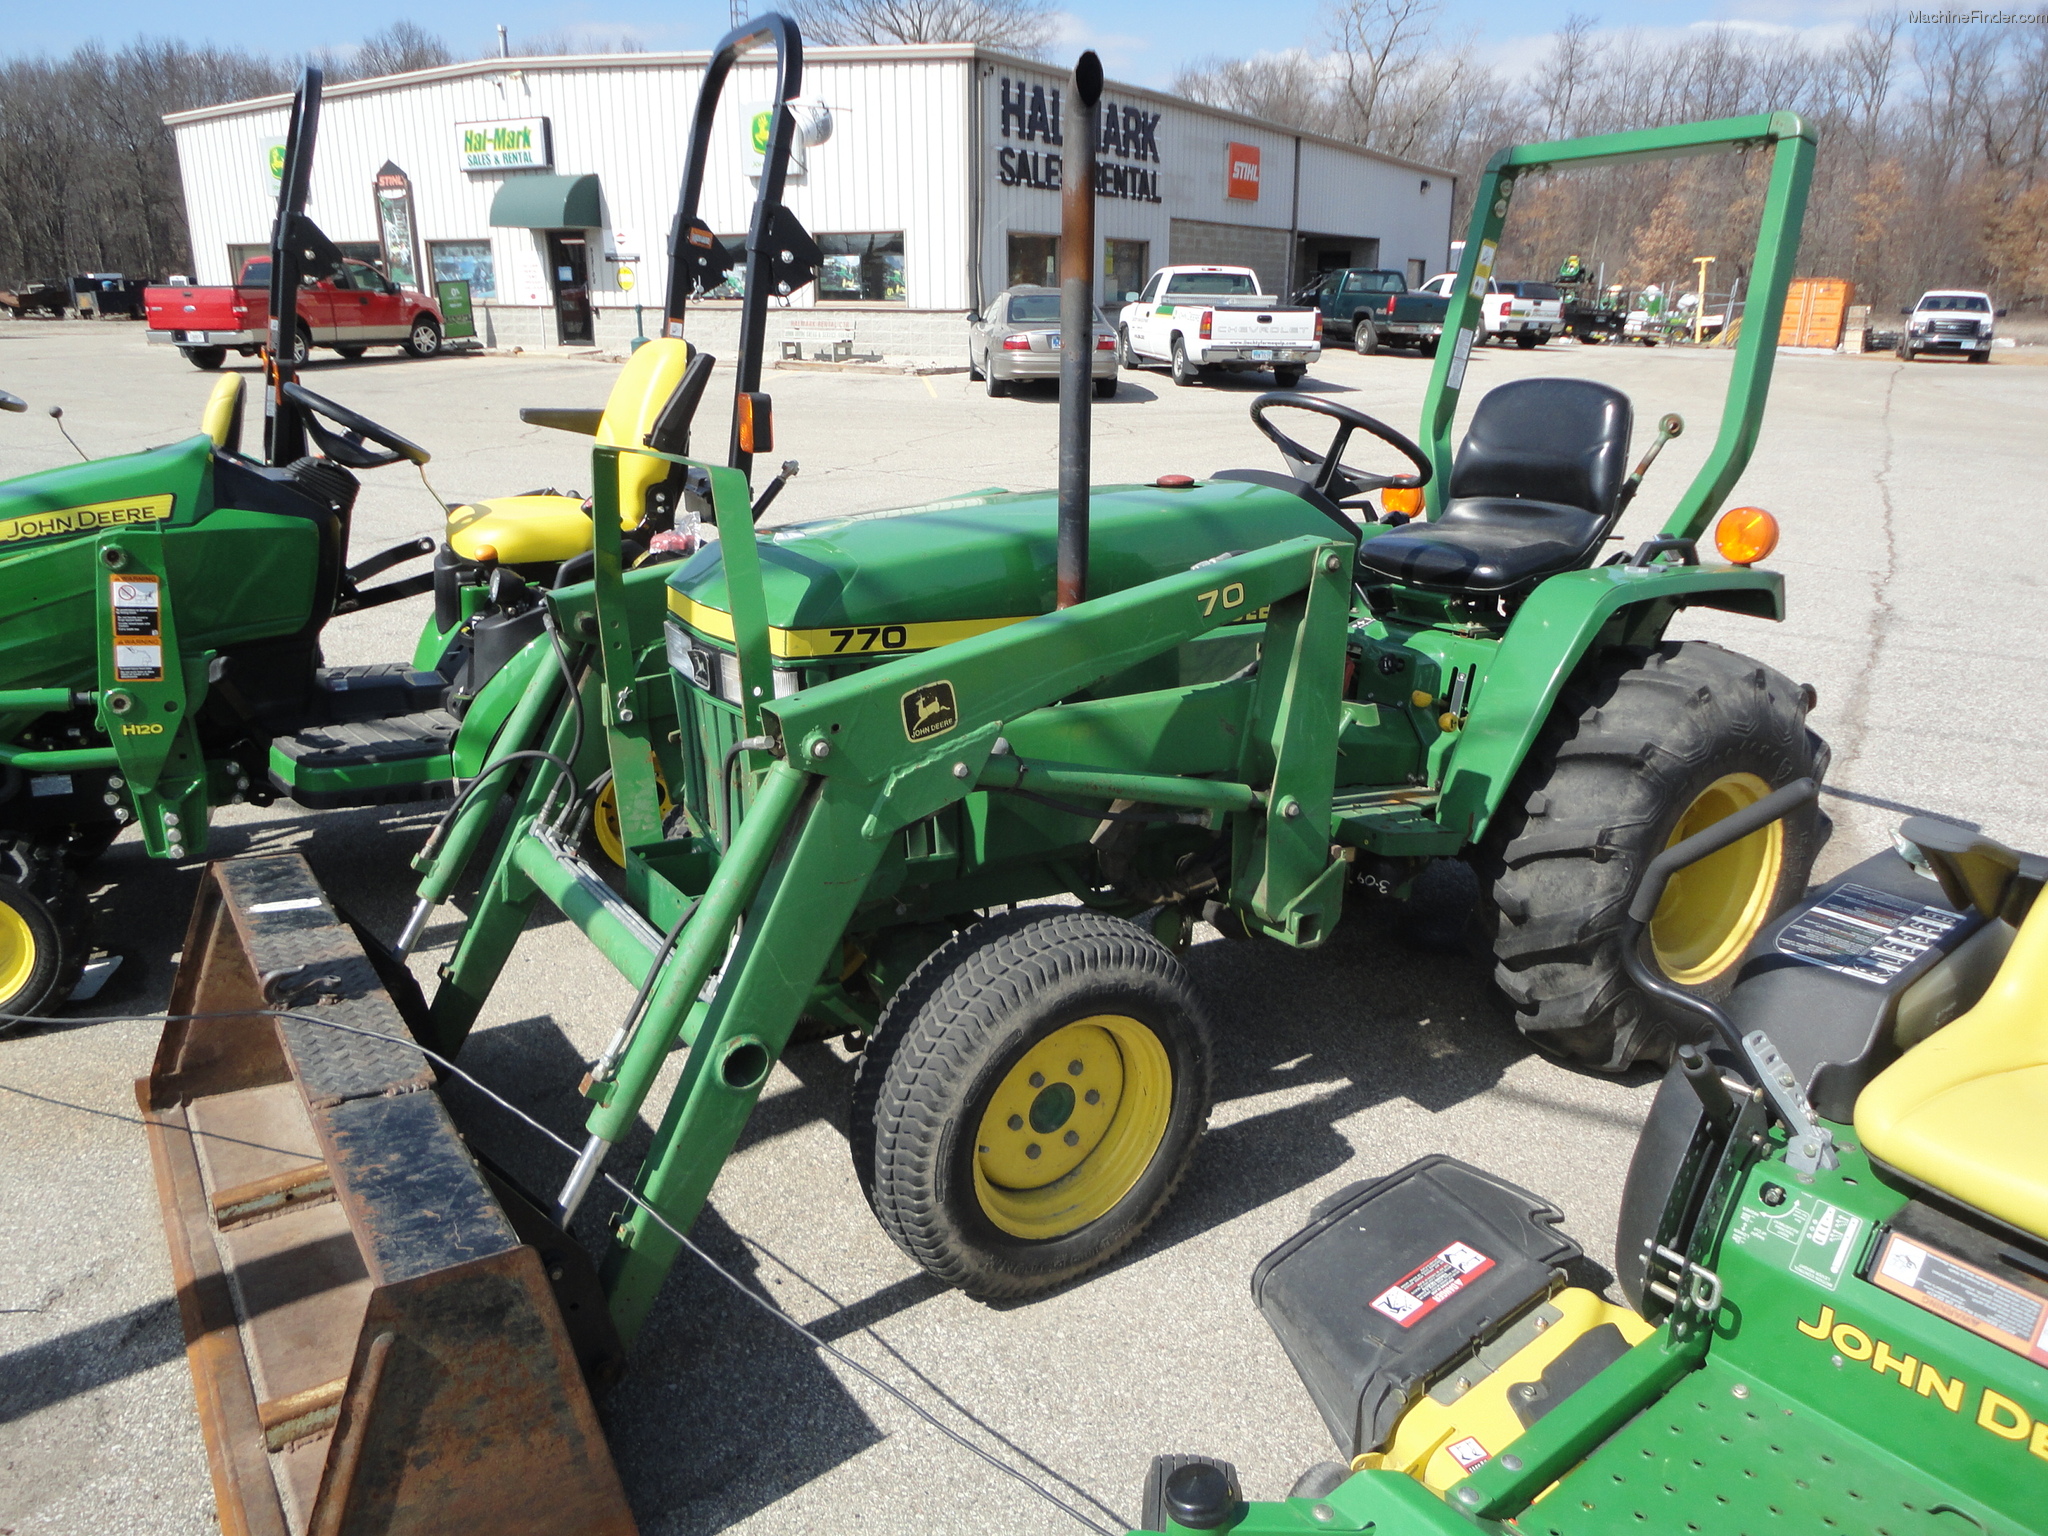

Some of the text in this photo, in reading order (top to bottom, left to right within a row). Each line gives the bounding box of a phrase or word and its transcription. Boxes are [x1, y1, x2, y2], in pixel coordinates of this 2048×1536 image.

[1001, 77, 1162, 164] HALARK
[464, 126, 532, 153] Hal-Mark
[467, 151, 533, 166] SALES & RENTAL
[1000, 147, 1063, 191] SALE
[1232, 161, 1259, 182] STIHL
[1217, 326, 1309, 334] CHEVROLET
[7, 506, 157, 541] JOHN DEERE
[1197, 582, 1245, 617] 70
[830, 625, 907, 653] 770
[122, 723, 164, 736] H120
[911, 717, 953, 739] JOHN DEERE
[1797, 1303, 1966, 1414] JOHN
